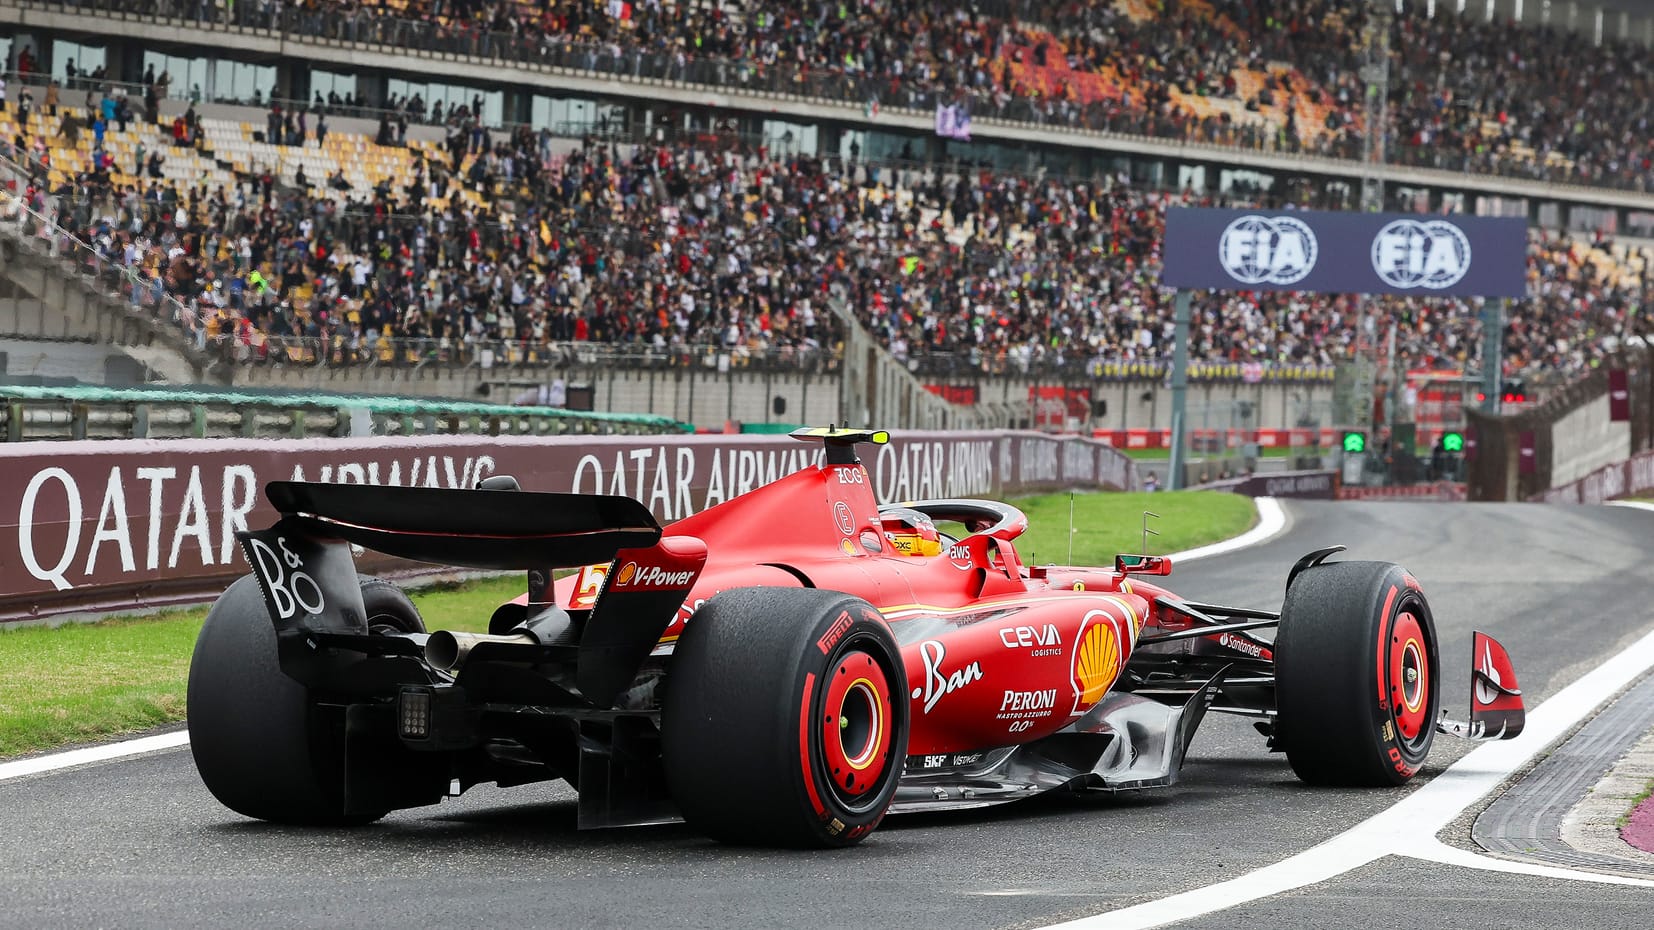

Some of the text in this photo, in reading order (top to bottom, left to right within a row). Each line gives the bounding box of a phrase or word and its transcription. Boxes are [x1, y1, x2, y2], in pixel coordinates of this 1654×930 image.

[876, 442, 944, 504] QATAR
[18, 464, 257, 591] QATAR
[950, 545, 970, 559] aws
[633, 566, 695, 586] V-Power
[1031, 648, 1062, 657] LOGISTICS
[1227, 635, 1262, 658] Santander
[1000, 689, 1057, 711] PERONI
[924, 755, 947, 768] SKF
